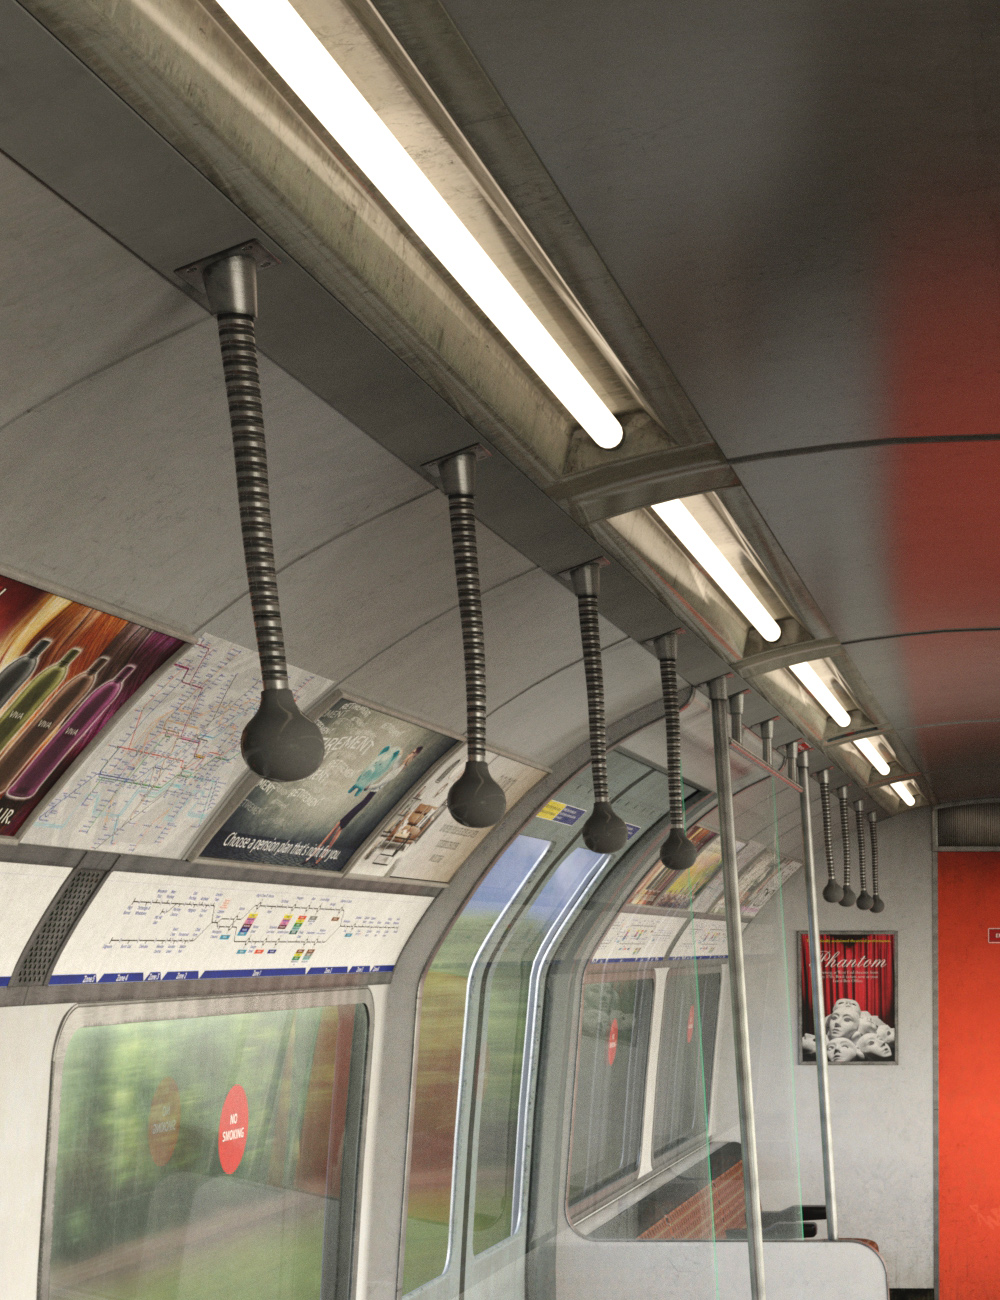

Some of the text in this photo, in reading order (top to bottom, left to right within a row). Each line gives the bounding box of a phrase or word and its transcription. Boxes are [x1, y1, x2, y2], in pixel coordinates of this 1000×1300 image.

[223, 832, 250, 848] Choose
[249, 838, 280, 856] pension
[274, 840, 294, 856] plan
[290, 841, 310, 856] that's
[809, 951, 887, 968] Phantom
[230, 1113, 238, 1125] NO
[222, 1127, 244, 1142] SMOKING
